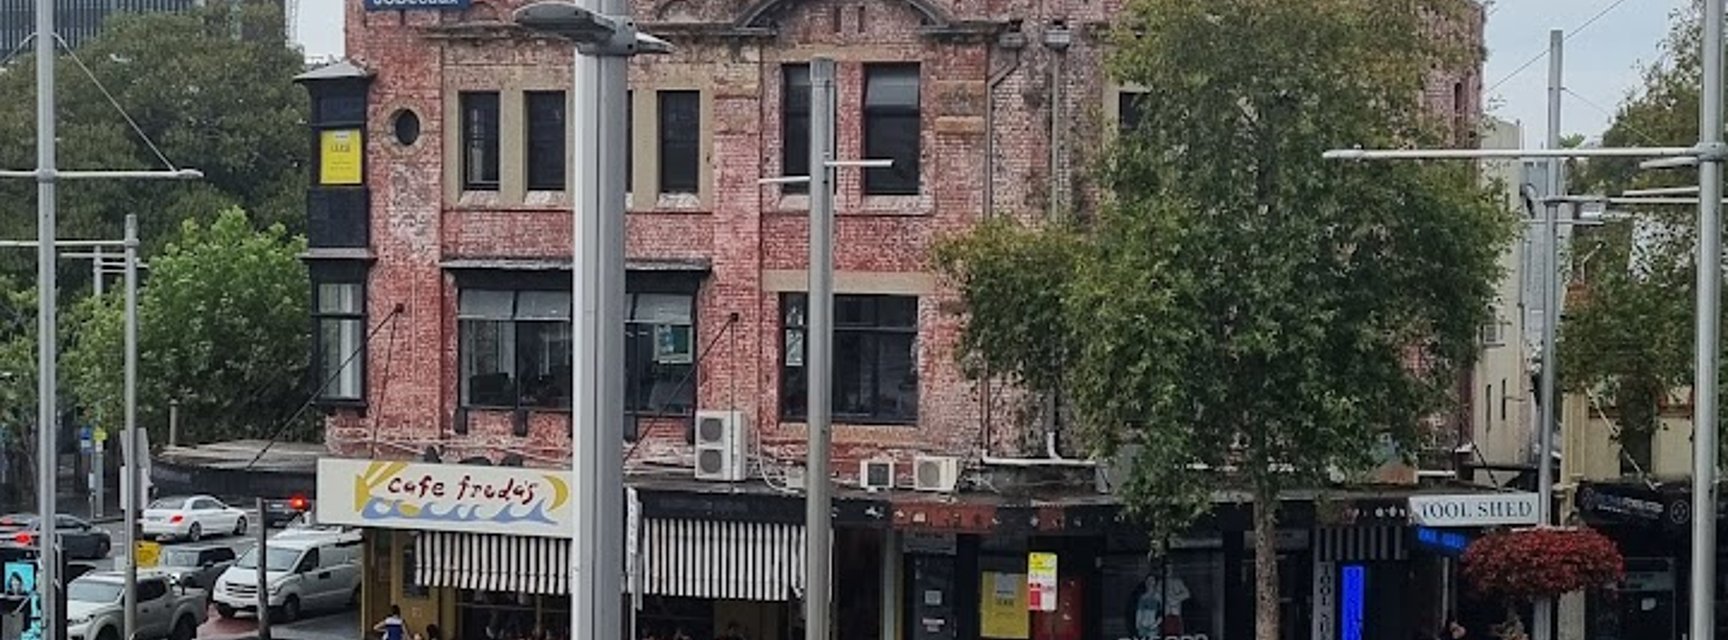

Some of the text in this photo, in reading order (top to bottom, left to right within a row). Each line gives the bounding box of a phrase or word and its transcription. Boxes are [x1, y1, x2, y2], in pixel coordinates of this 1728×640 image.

[387, 475, 445, 498] cafe
[1421, 501, 1532, 519] TOOL SHED
